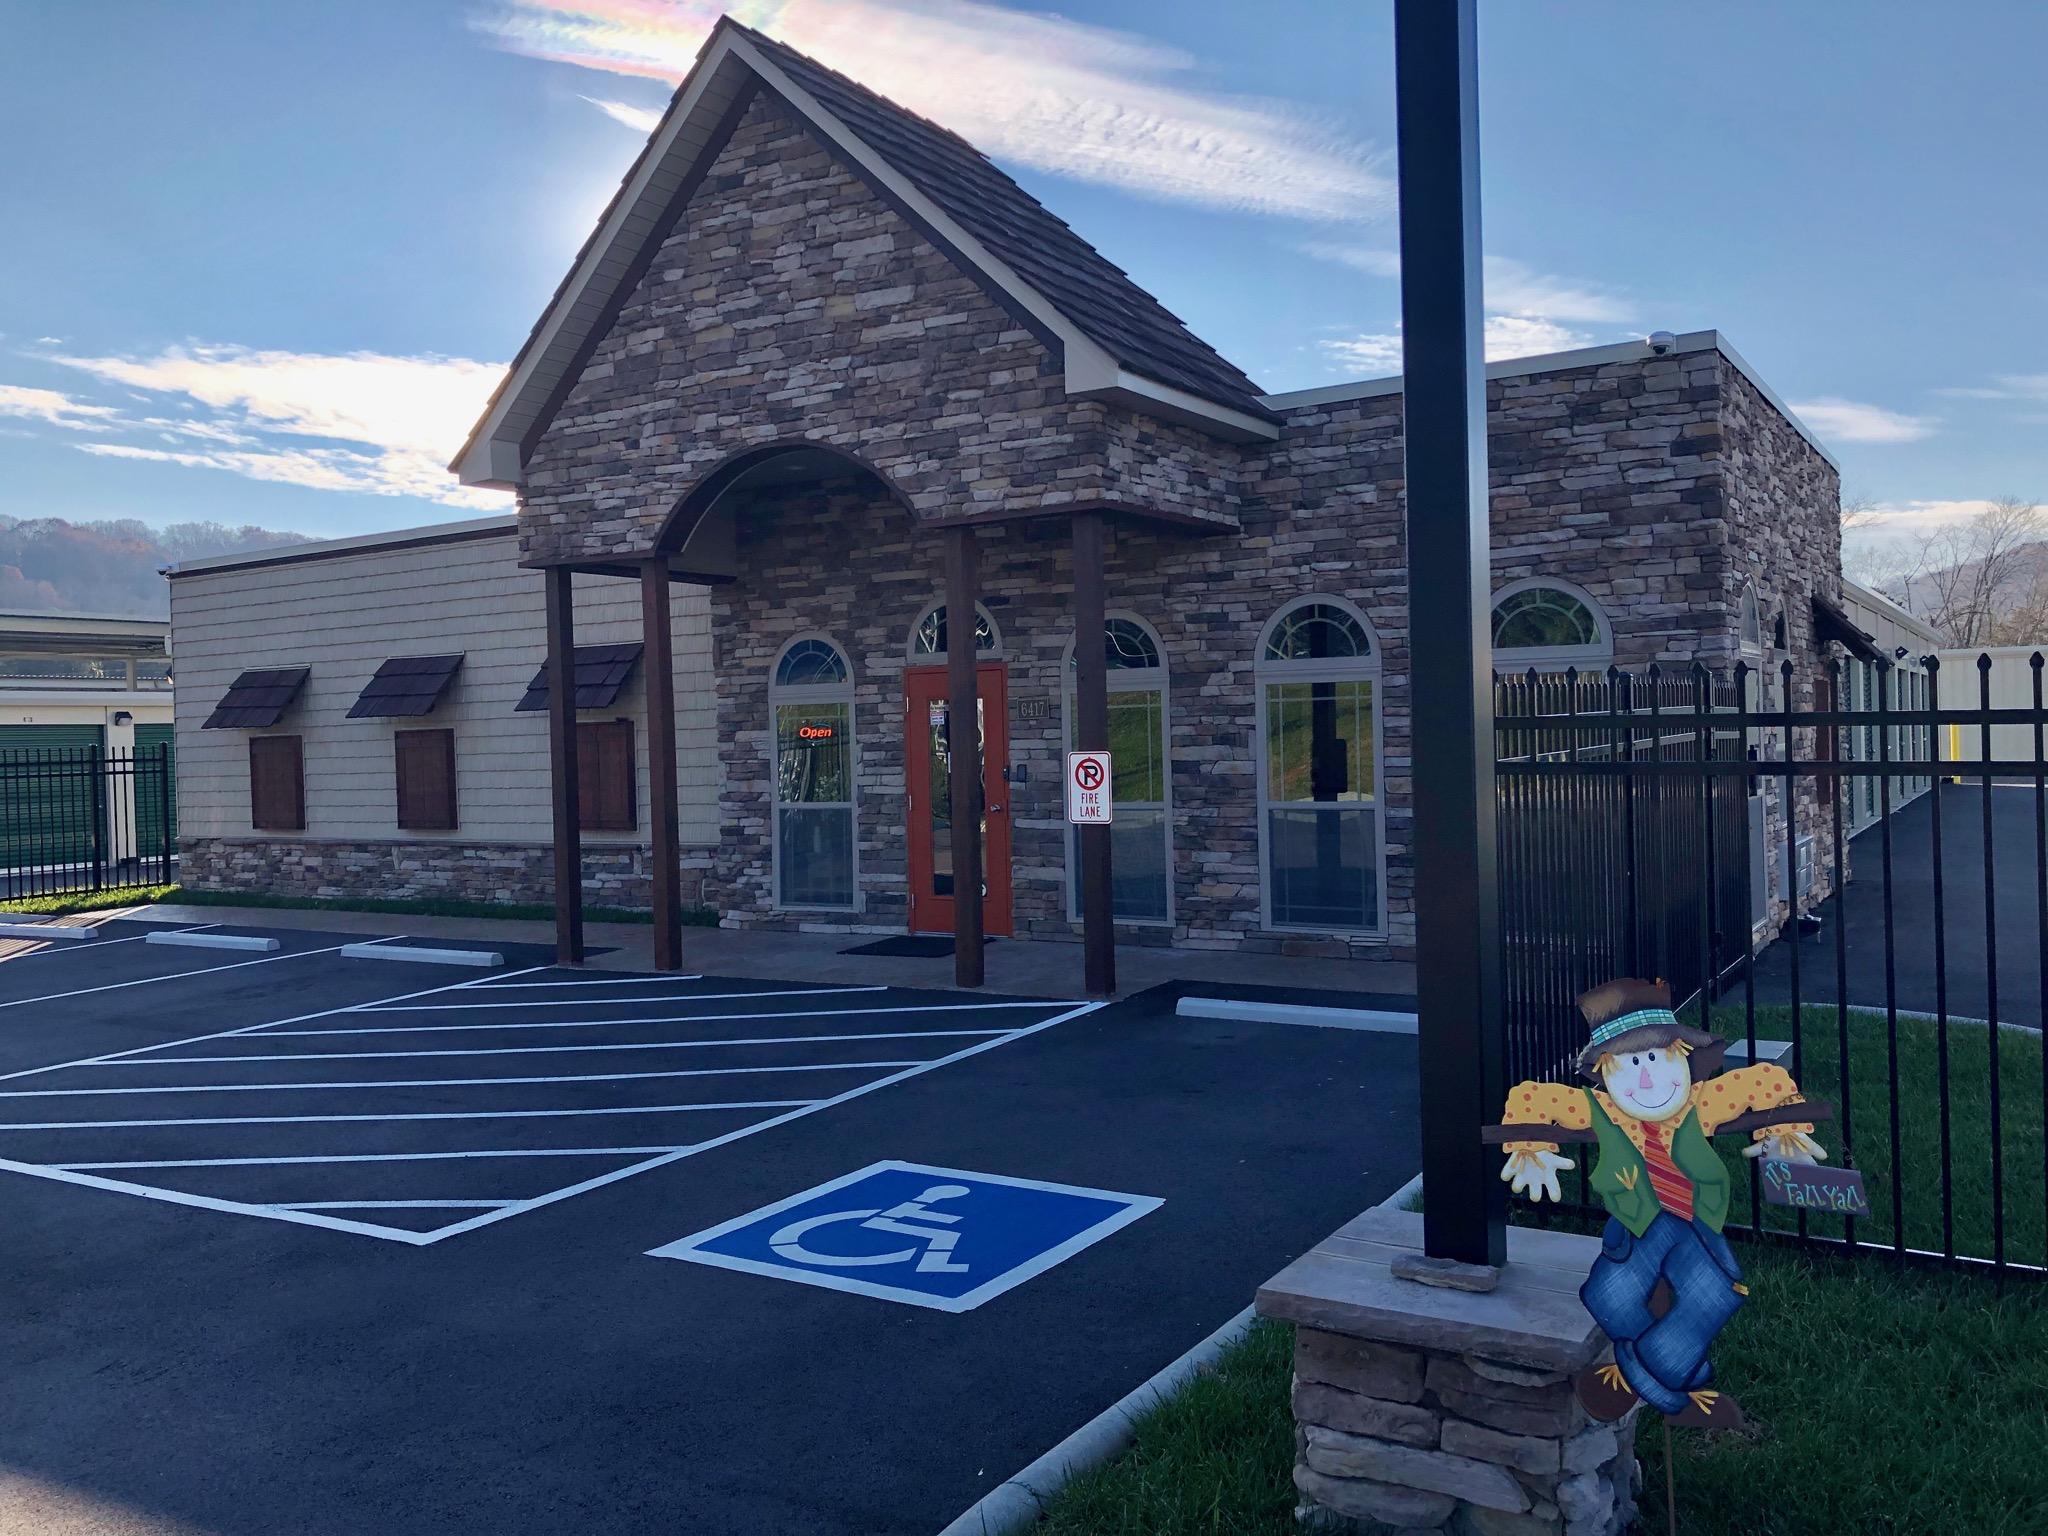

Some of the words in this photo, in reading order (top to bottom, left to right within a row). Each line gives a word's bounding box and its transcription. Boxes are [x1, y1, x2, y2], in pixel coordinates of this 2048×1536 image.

[1021, 702, 1045, 717] 6417
[800, 727, 832, 739] Open
[1081, 793, 1099, 804] FIRE
[1080, 806, 1101, 817] LANE
